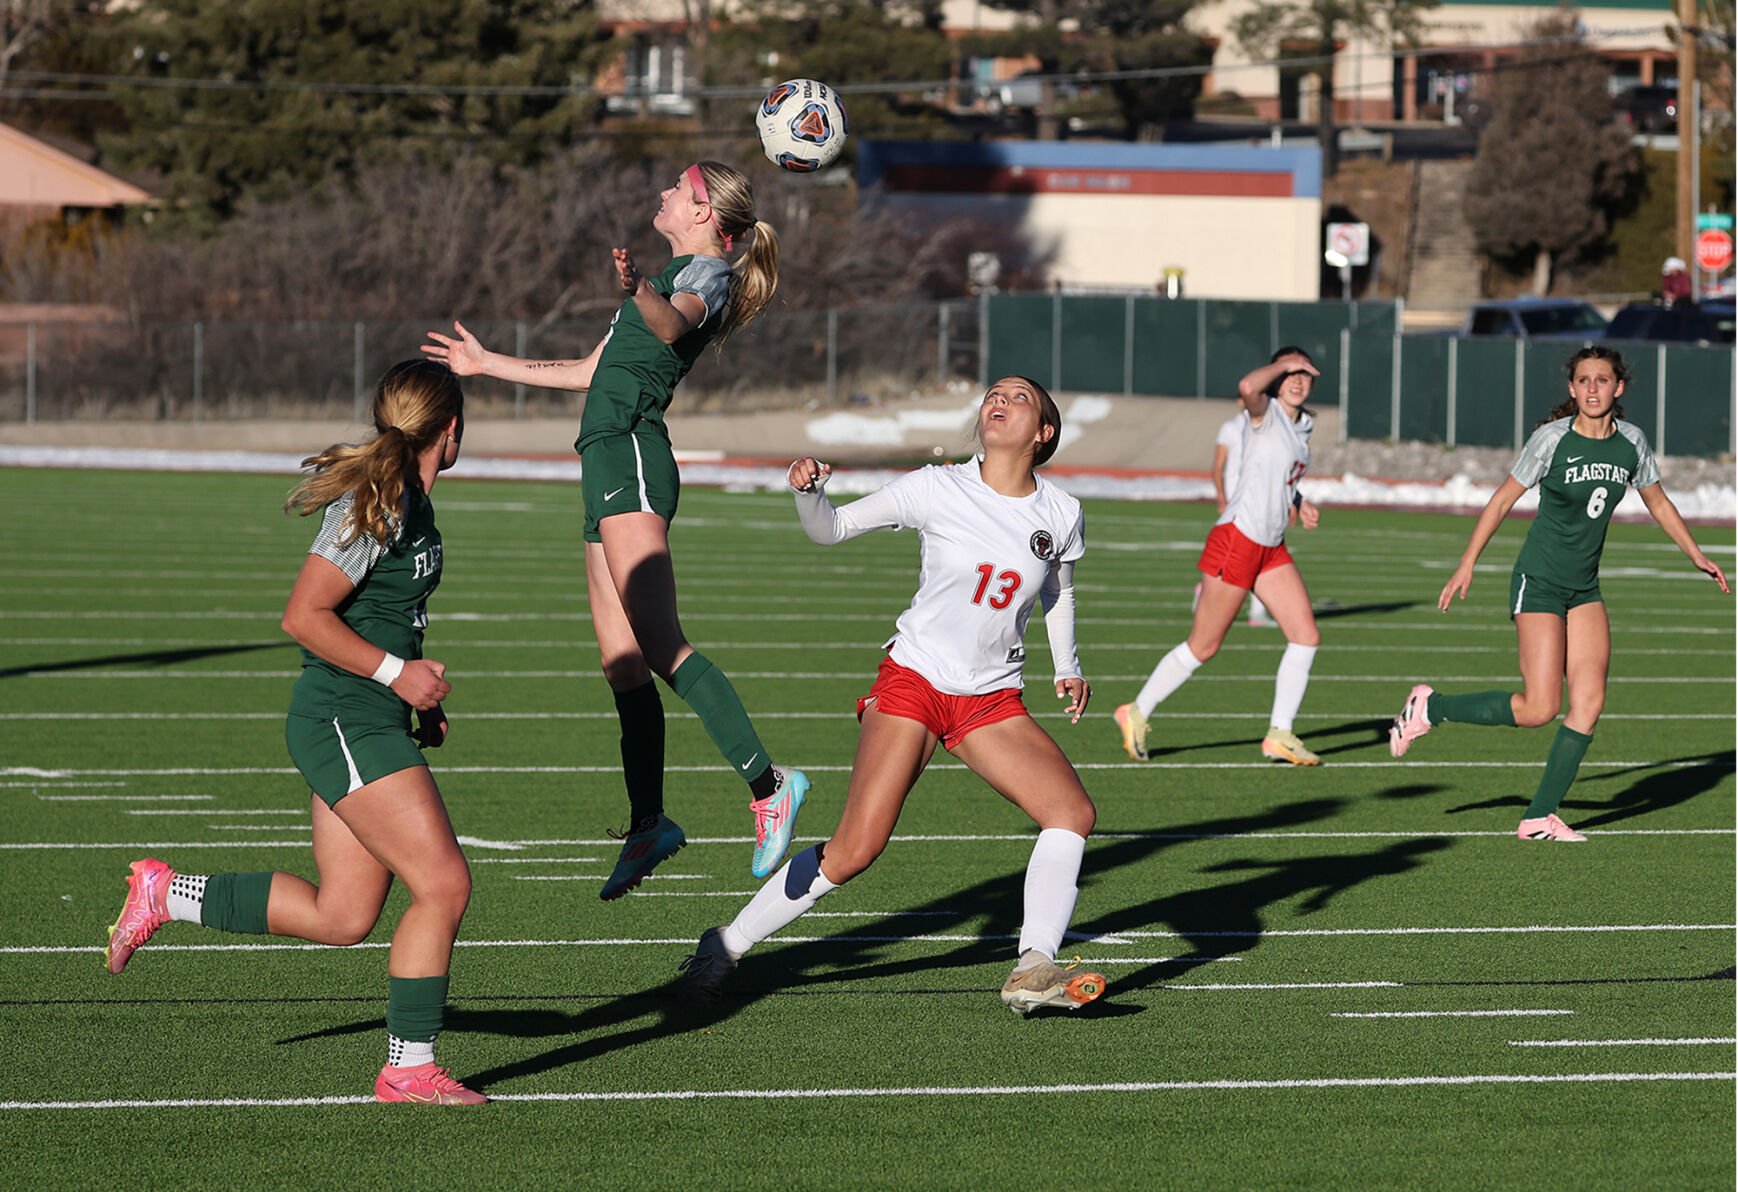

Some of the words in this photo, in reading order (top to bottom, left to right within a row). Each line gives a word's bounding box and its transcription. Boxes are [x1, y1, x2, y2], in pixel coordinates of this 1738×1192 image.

[1698, 241, 1732, 257] STOP
[1586, 486, 1608, 519] 6
[971, 562, 1023, 611] 13
